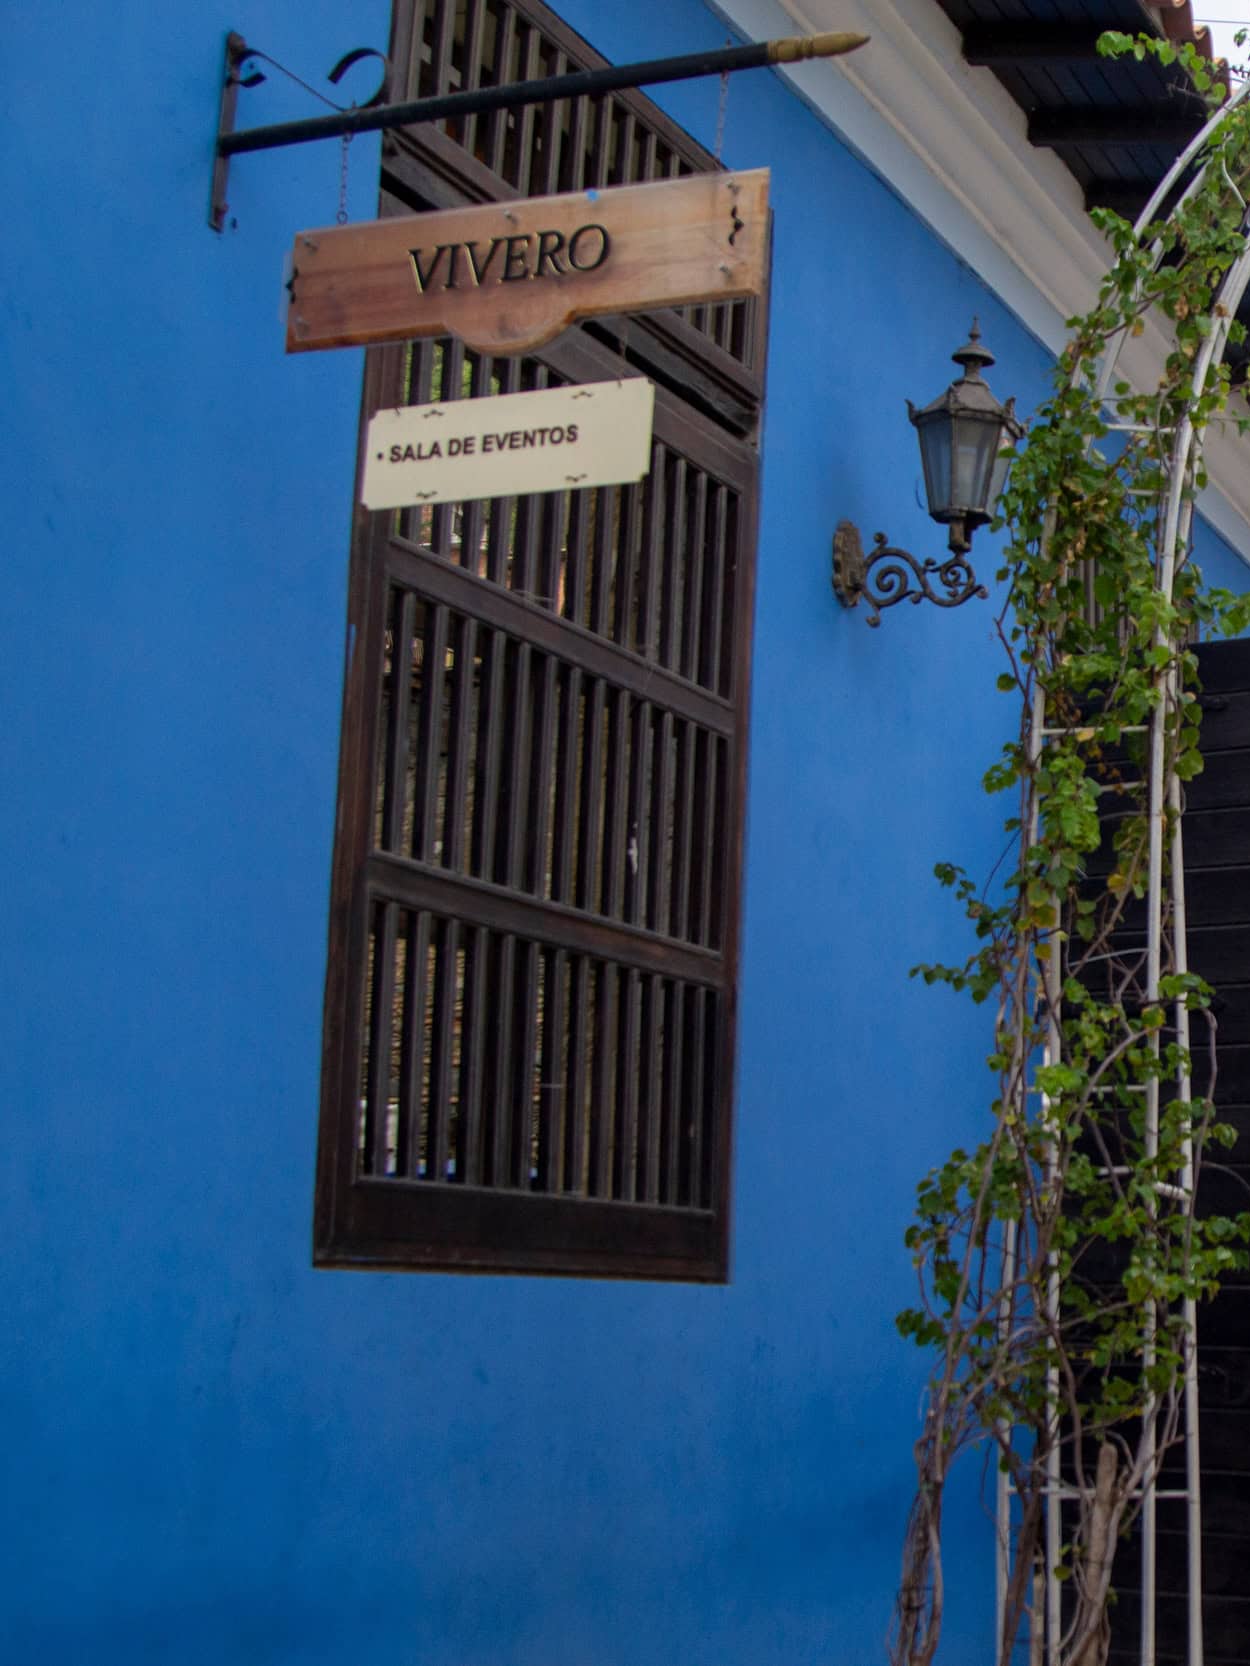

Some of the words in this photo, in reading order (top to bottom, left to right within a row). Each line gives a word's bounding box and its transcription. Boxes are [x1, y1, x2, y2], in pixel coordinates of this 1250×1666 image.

[408, 223, 611, 295] VIVERO
[389, 441, 443, 463] SALA
[447, 436, 476, 457] DE
[481, 424, 579, 453] EVENTOS
